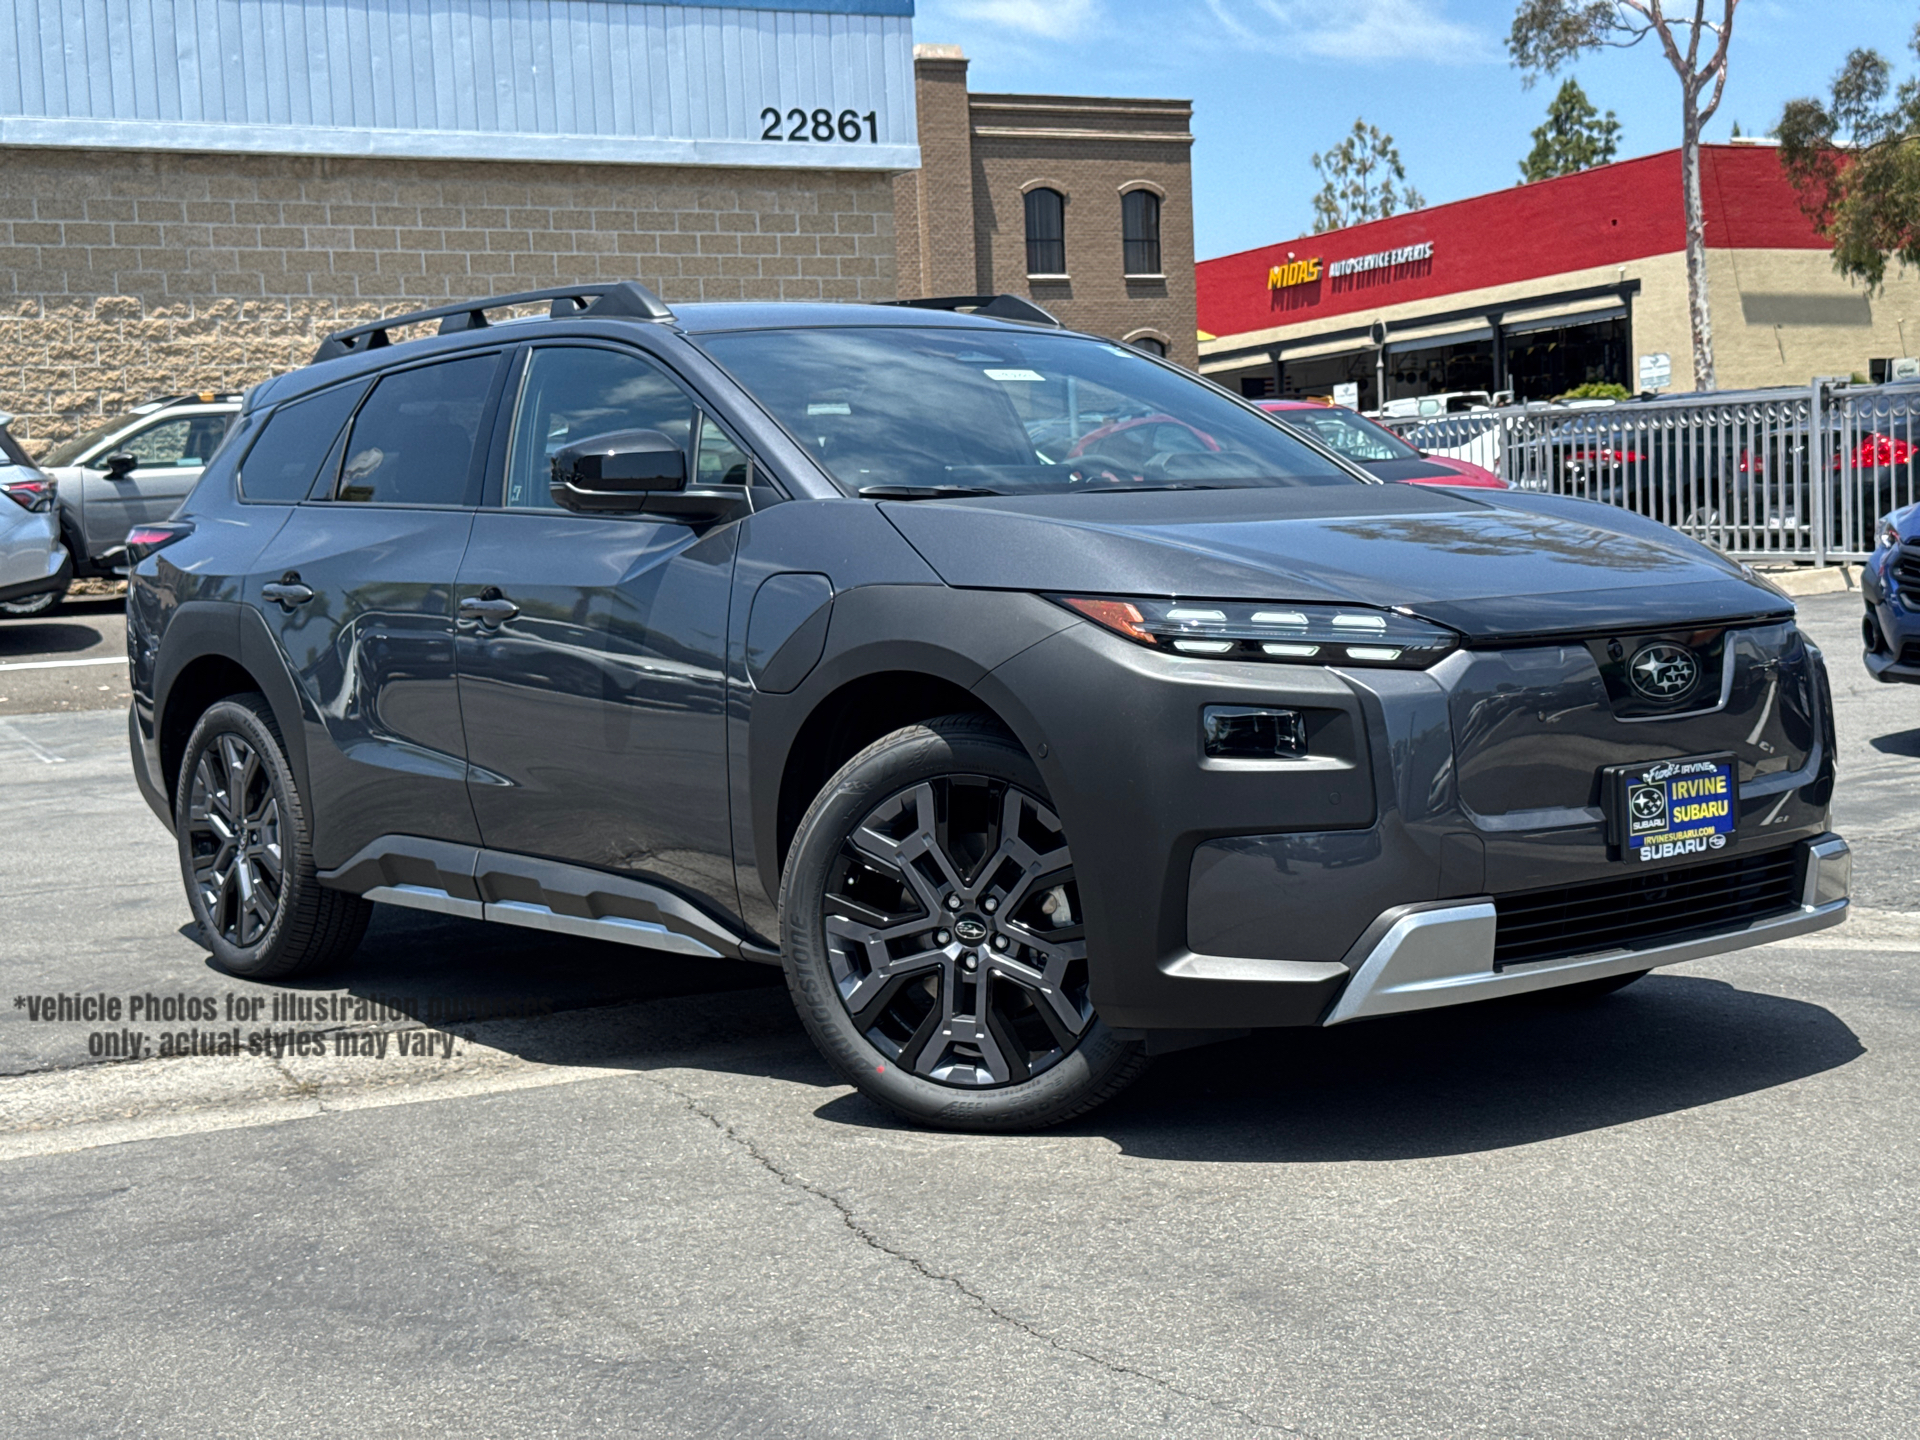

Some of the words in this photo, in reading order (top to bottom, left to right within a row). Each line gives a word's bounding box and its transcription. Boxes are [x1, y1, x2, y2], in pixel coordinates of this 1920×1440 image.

[760, 107, 878, 144] 22861
[1267, 254, 1323, 290] MIDAS
[1328, 260, 1355, 278] AUTO
[1353, 250, 1390, 273] SERVICE
[1390, 241, 1434, 266] EXPERTS
[1681, 762, 1711, 775] IRVINE
[1672, 775, 1727, 801] IRVINE
[1633, 818, 1665, 830] SUBARU
[1673, 799, 1729, 824] SUBARU
[1644, 826, 1715, 846] IRVINESUBARU.COM
[1640, 837, 1707, 862] SUBARU
[790, 913, 876, 1078] BRIDGESTONE
